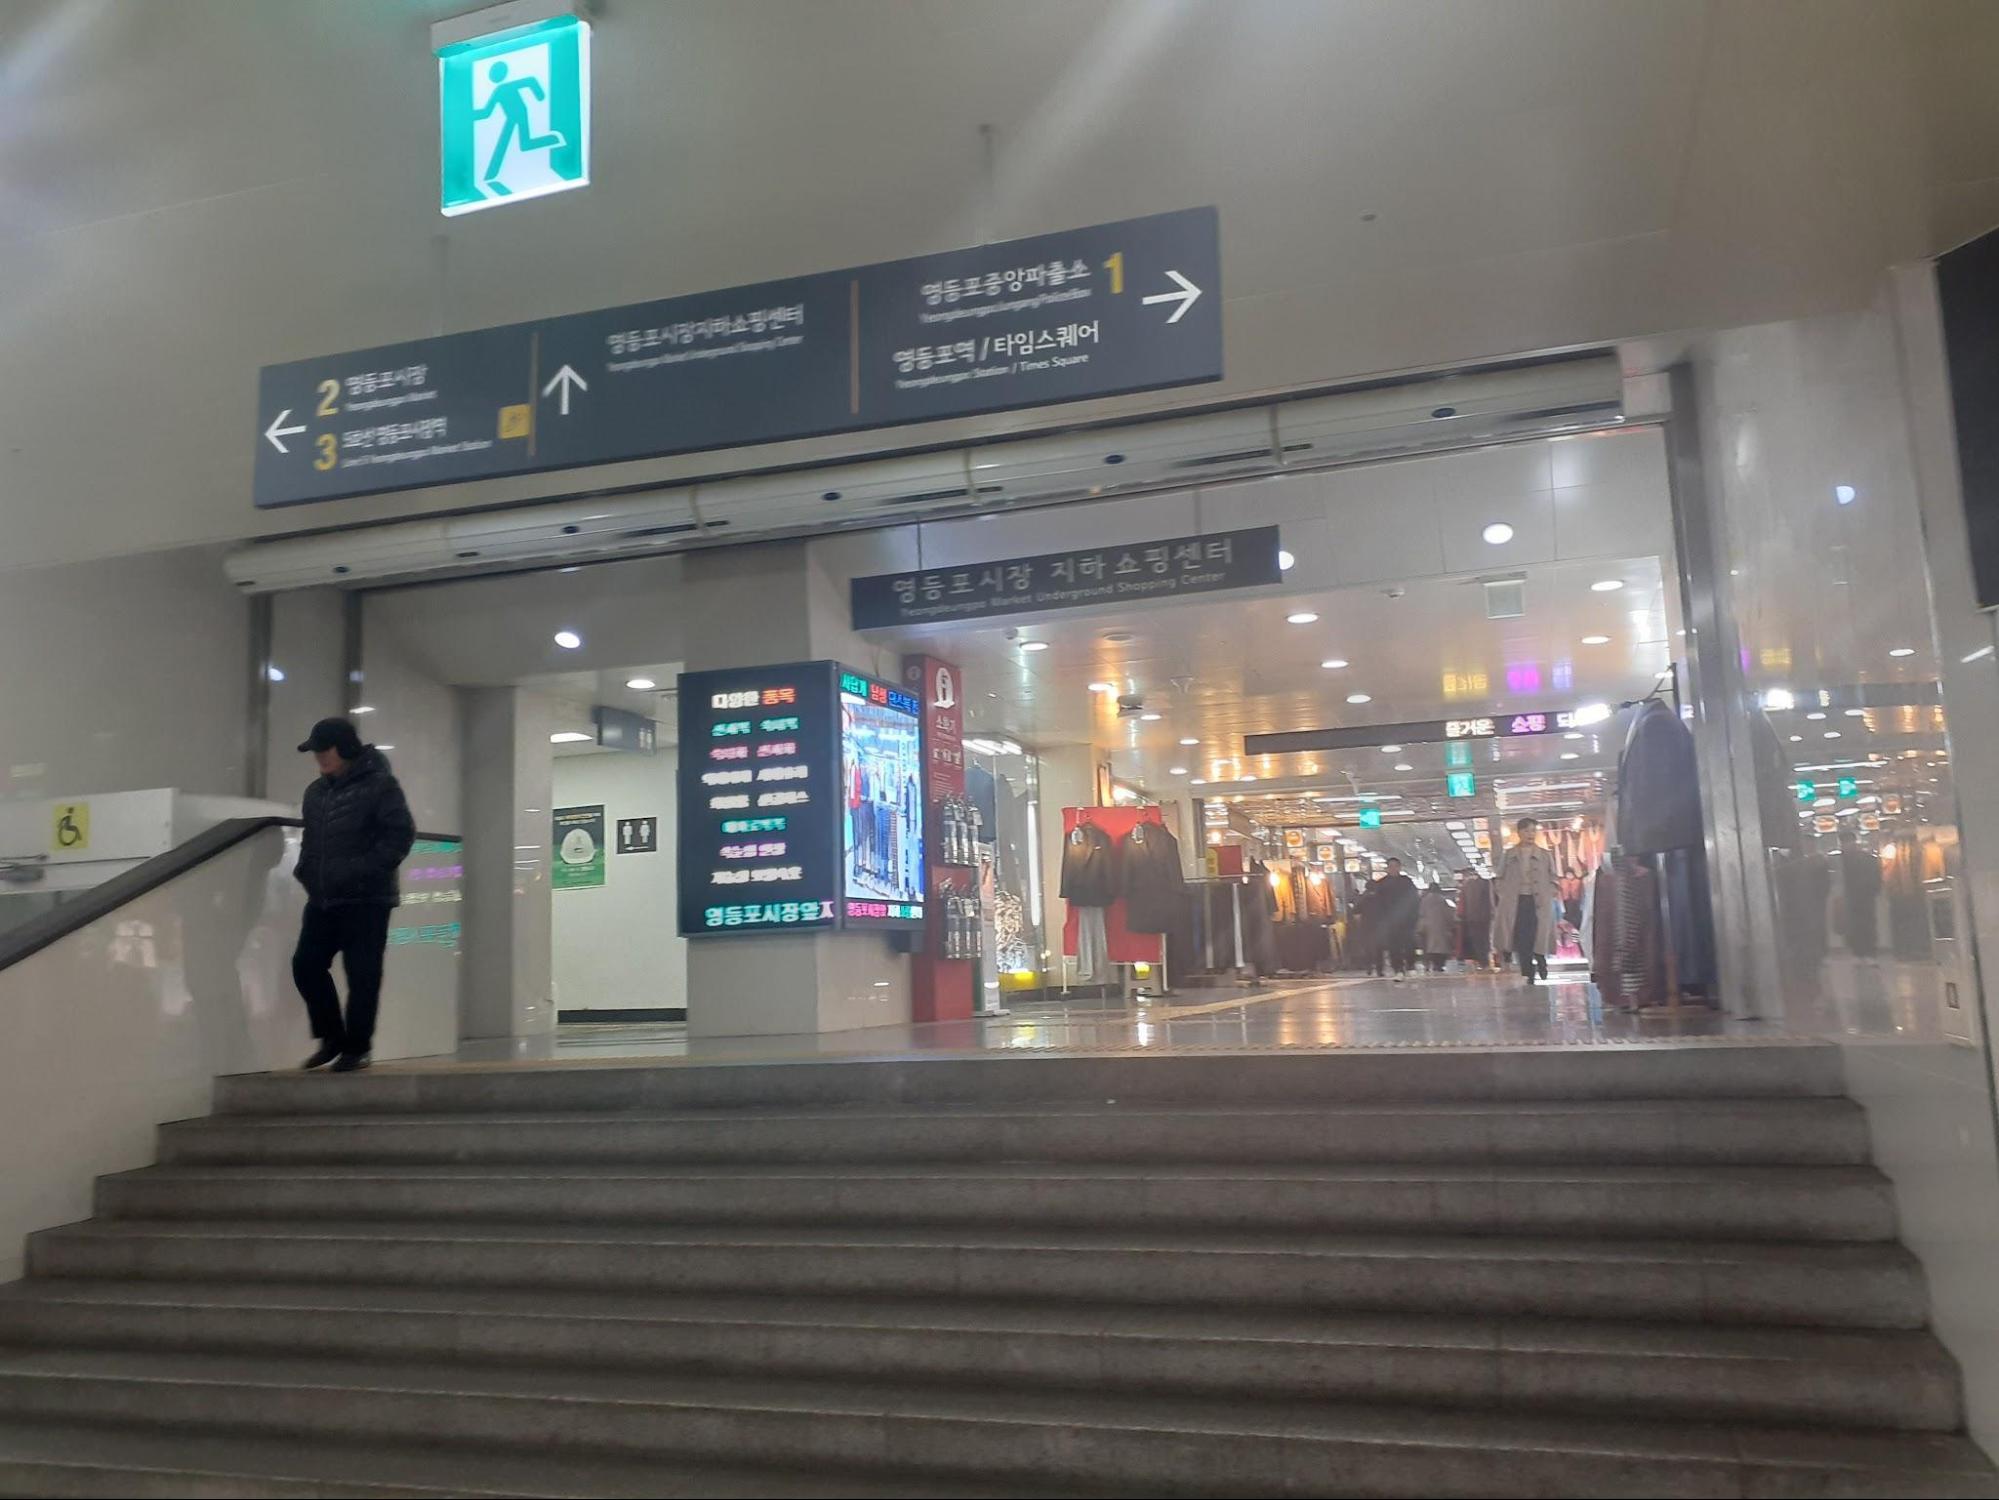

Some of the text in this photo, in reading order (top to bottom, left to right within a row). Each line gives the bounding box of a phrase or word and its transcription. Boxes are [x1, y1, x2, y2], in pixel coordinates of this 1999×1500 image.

[1102, 252, 1124, 295] 1
[892, 339, 977, 373] 영등포역
[993, 319, 1099, 357] 타임스퀘어
[1019, 359, 1050, 373] Times
[1052, 354, 1090, 369] Square
[315, 379, 340, 416] 2
[313, 433, 338, 471] 3
[892, 562, 1034, 604] 영등포시장
[1036, 584, 1114, 603] Underground
[1117, 576, 1177, 595] Shopping
[1180, 571, 1227, 586] Center
[1445, 718, 1495, 738] 즐거운
[1511, 714, 1546, 734] 쇼핑
